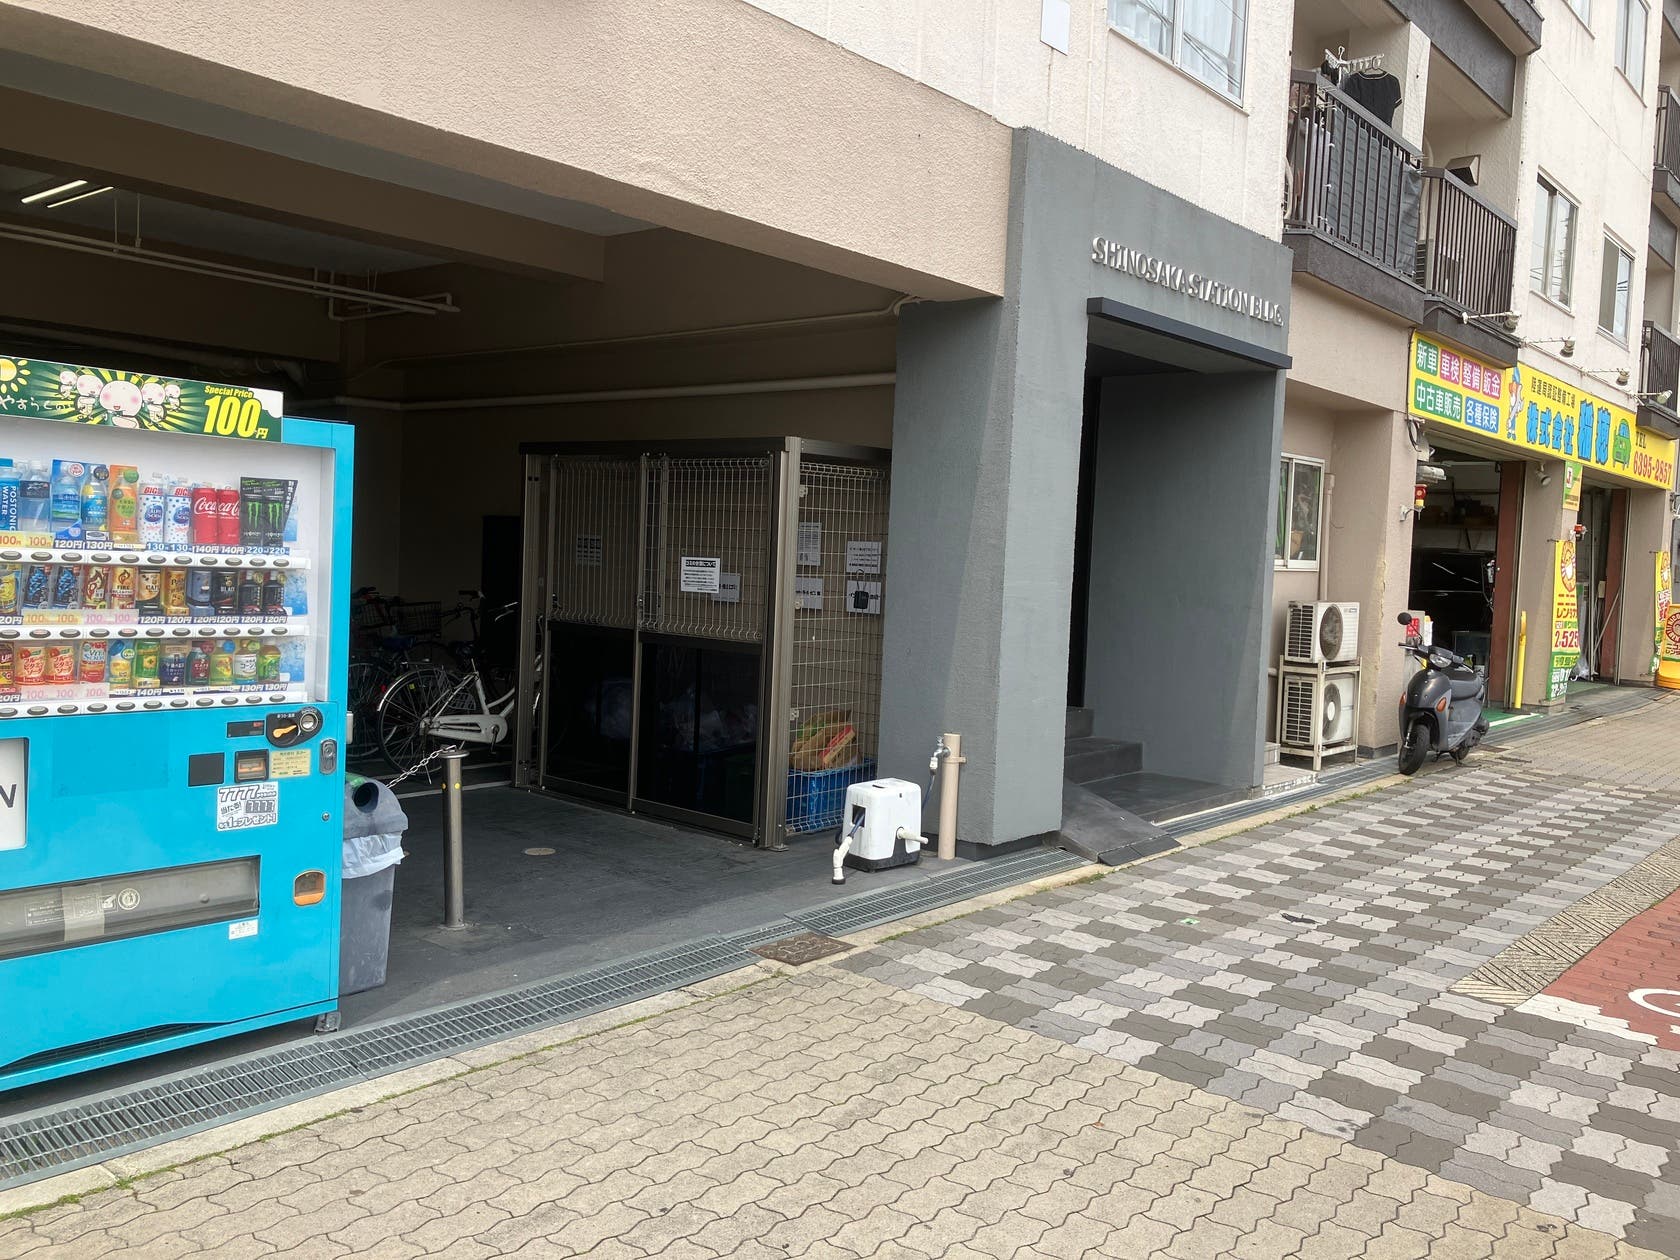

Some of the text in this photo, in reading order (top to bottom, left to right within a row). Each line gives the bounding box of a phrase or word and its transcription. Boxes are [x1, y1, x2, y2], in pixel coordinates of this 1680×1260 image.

[1091, 236, 1188, 293] SHINOSAKA
[1188, 273, 1250, 314] STATION
[1417, 342, 1437, 373] 新車
[1441, 353, 1460, 382] 車検
[1463, 361, 1480, 389] 整備
[204, 385, 254, 399] Special Price
[1416, 381, 1498, 431] 中古車販売 各種保険
[203, 395, 269, 439] 100円
[1635, 431, 1647, 449] TEL
[1633, 451, 1672, 485] 6395-2857
[1, 486, 9, 515] WATER
[55, 540, 83, 548] 120円
[87, 541, 113, 549] 130円
[221, 546, 244, 554] 140円
[141, 616, 165, 624] 120円
[168, 616, 192, 624] 120円
[241, 616, 263, 624] 120円
[265, 616, 287, 624] 120円
[137, 688, 162, 696] 140円
[219, 785, 260, 803] 7777
